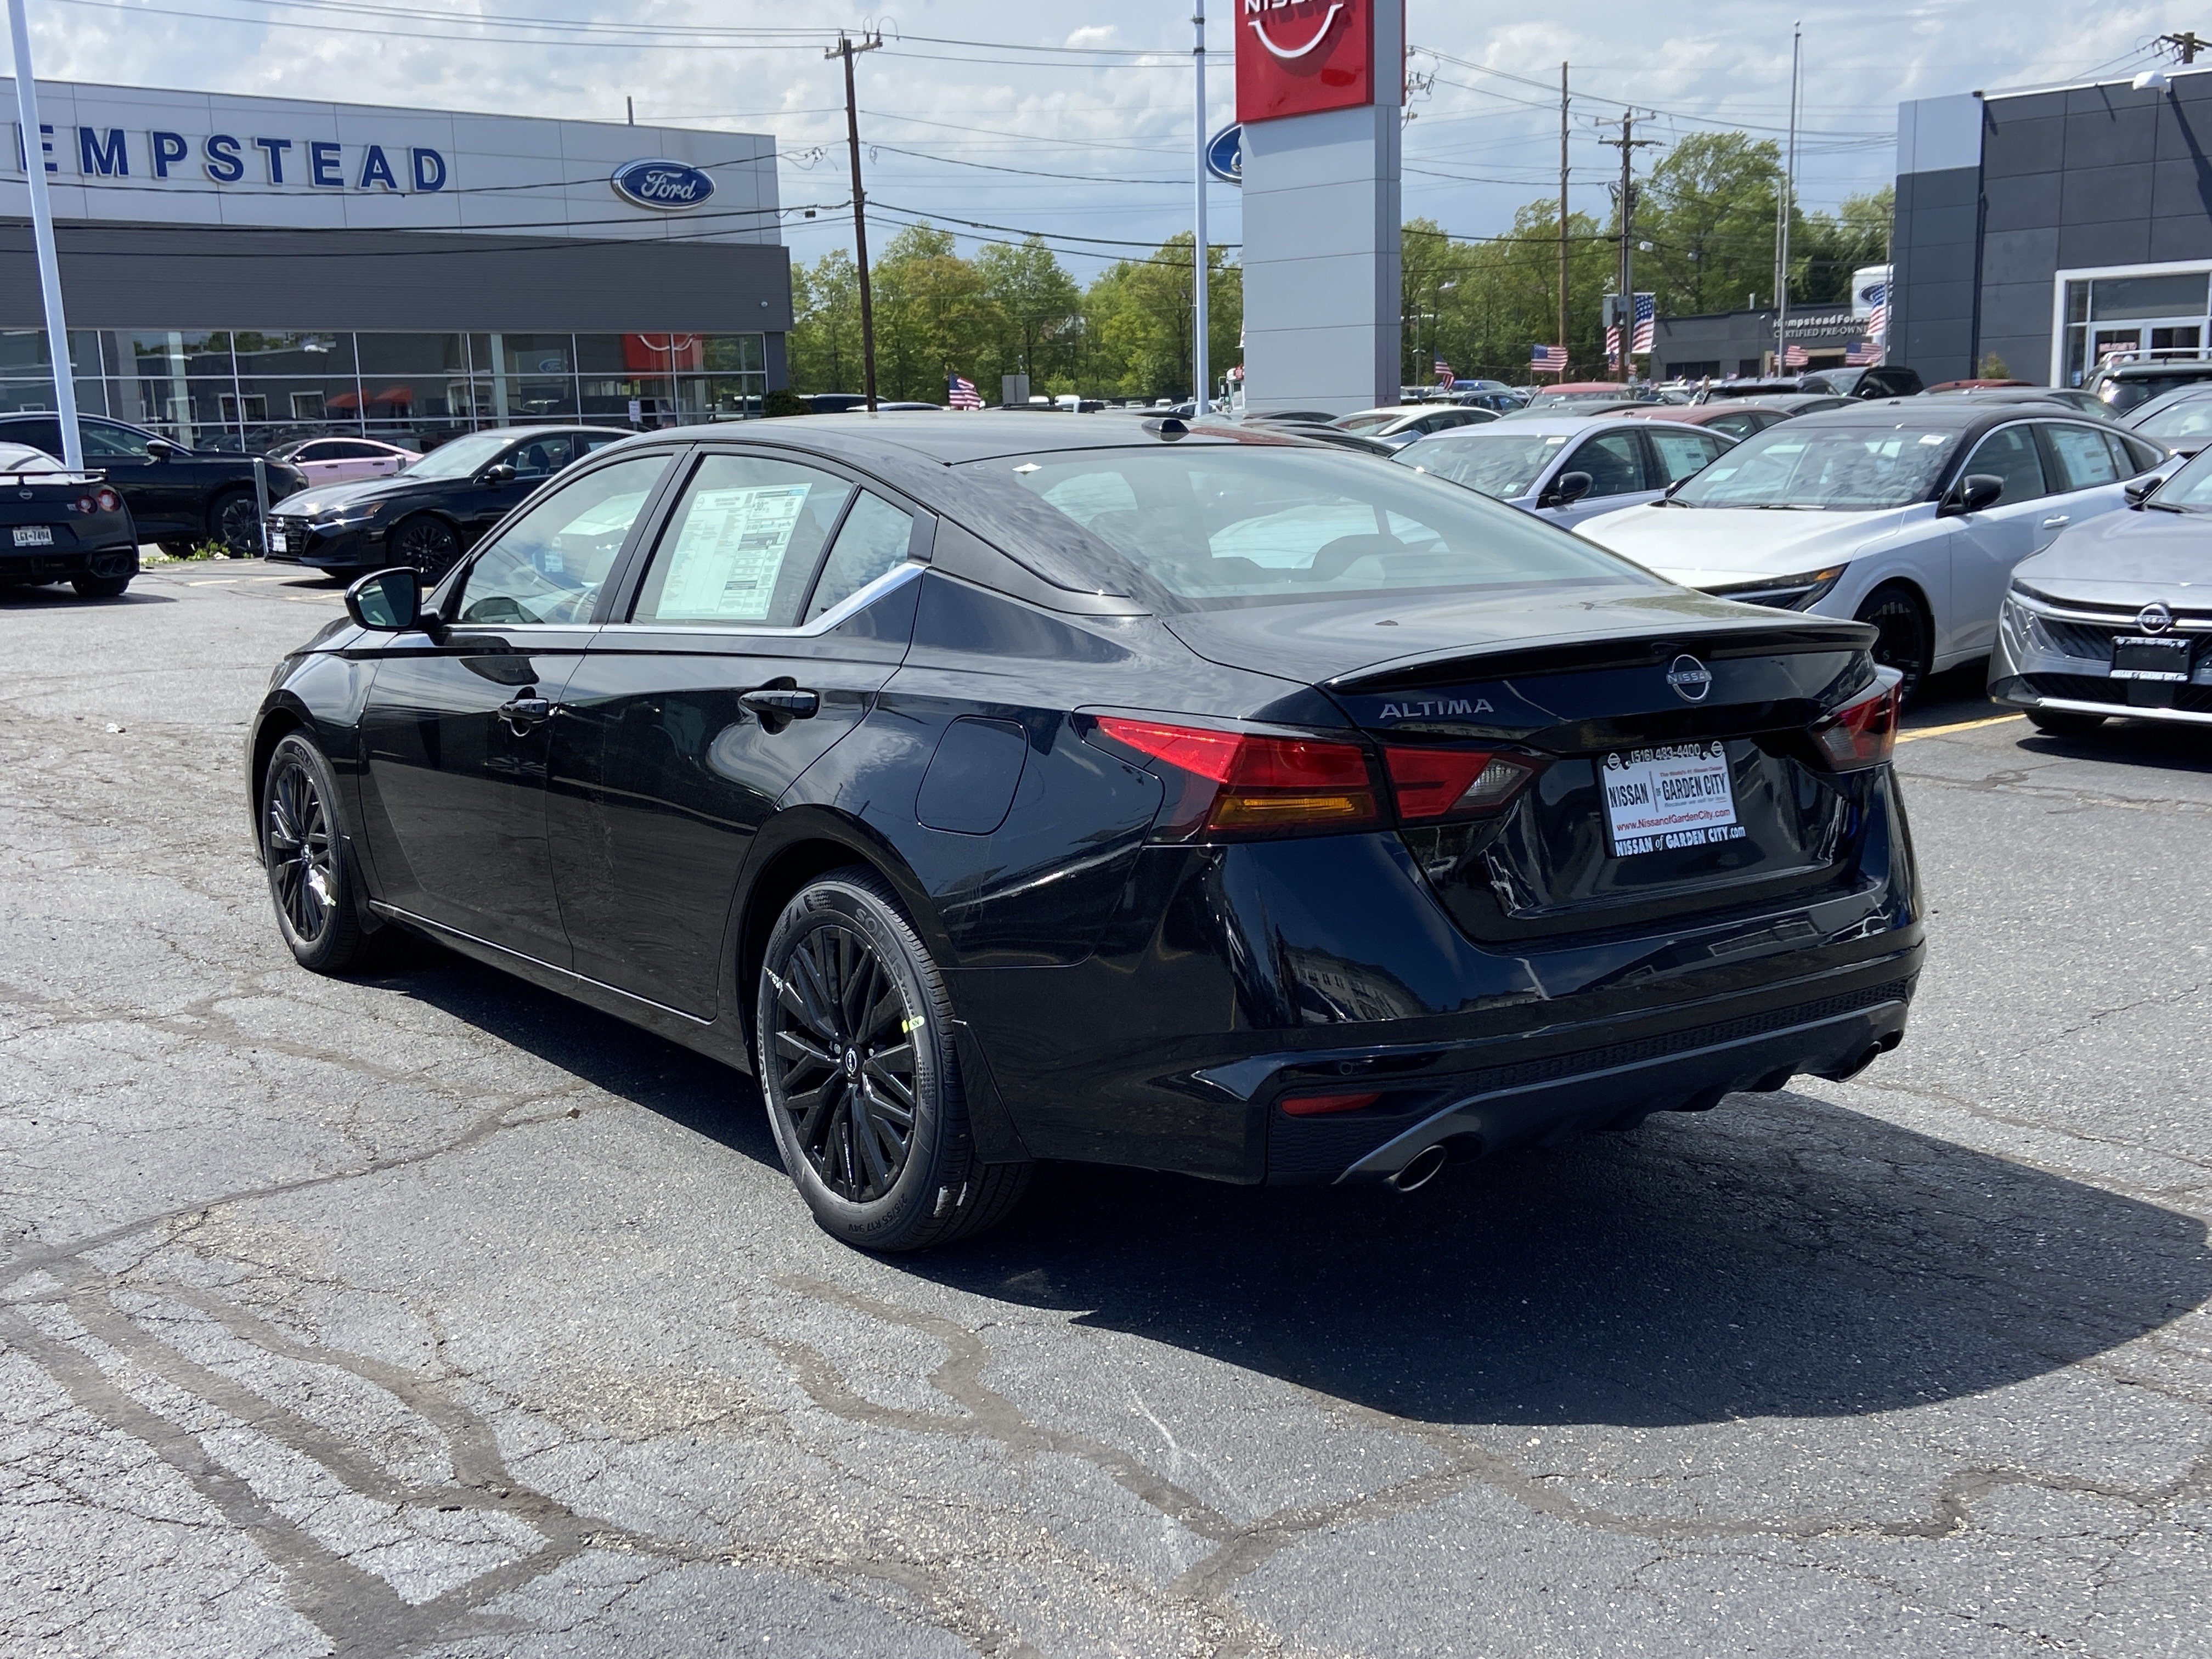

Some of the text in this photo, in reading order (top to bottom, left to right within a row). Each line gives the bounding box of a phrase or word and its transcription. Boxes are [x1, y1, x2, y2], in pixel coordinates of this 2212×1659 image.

[640, 170, 697, 200] Ford
[1774, 328, 1818, 338] CRTIFIED
[1667, 672, 1711, 682] NISSAN
[1379, 698, 1494, 719] ALTIMA
[1630, 748, 1654, 763] (516)
[1608, 782, 1649, 808] NISSAN
[1662, 775, 1703, 801] GARDEN
[1703, 772, 1726, 795] CITY
[1616, 809, 1730, 832] www.NissanofGardenCity.com
[1615, 837, 1654, 857] NISSAN
[1655, 834, 1664, 851] of
[1666, 829, 1706, 849] GARDEN
